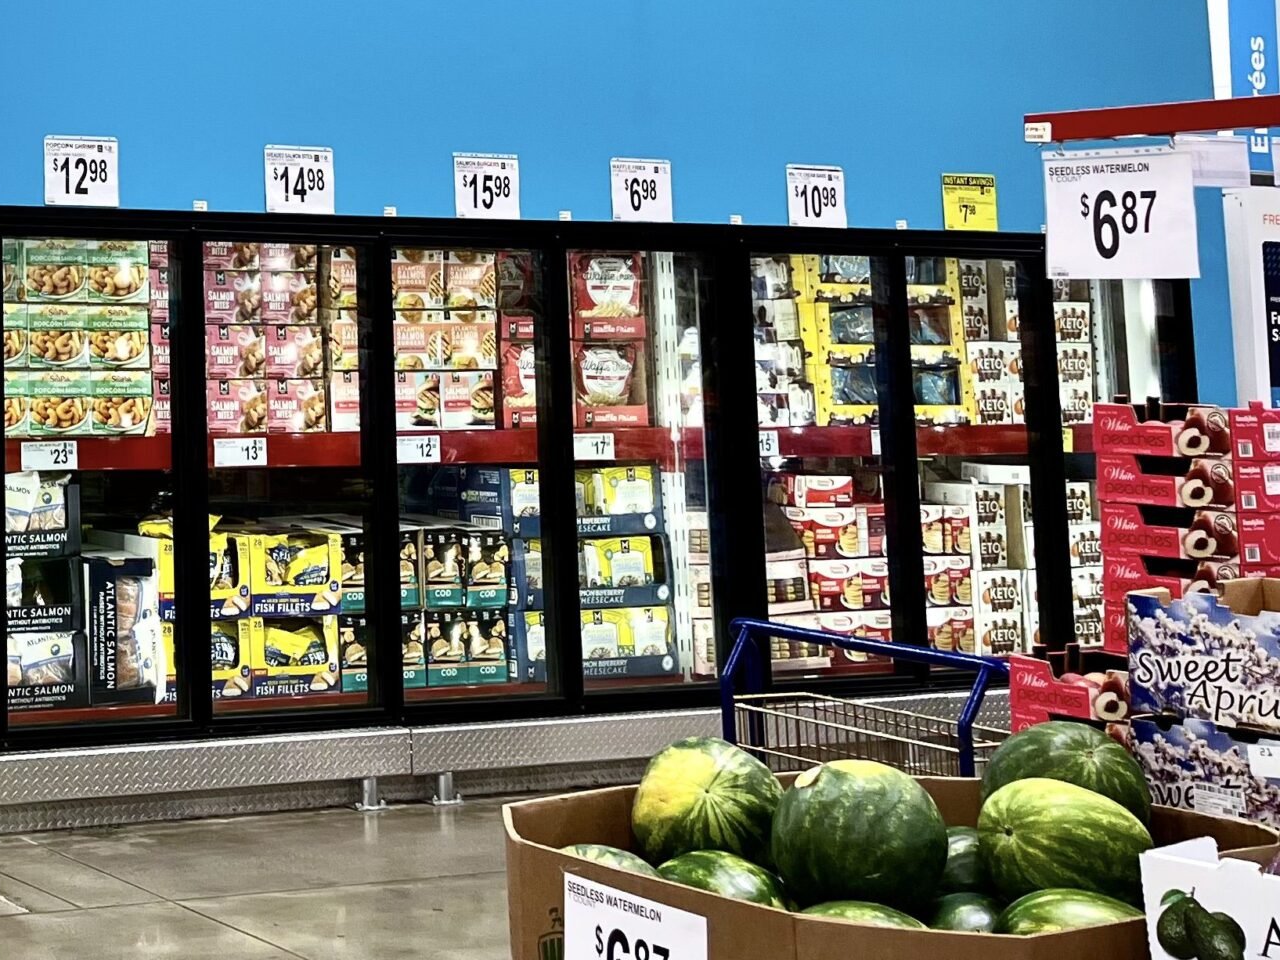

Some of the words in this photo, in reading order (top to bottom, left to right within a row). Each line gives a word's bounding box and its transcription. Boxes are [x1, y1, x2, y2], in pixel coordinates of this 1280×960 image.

[1048, 166, 1091, 176] SEEDLESS
[1092, 163, 1149, 174] WATERMELON
[943, 176, 967, 185] INSTANT
[969, 177, 994, 187] SAVINGS
[1056, 175, 1082, 183] COUNT
[962, 275, 981, 287] ETO
[208, 292, 234, 301] SALMON
[263, 292, 290, 301] SALMON
[965, 316, 982, 327] ETO
[1059, 317, 1084, 329] KETO
[211, 346, 239, 355] SALMON
[977, 358, 1003, 370] KETO
[1060, 359, 1086, 370] KETO
[211, 400, 239, 410] SALMON
[270, 400, 297, 410] SALMON
[979, 400, 1005, 411] KETO
[1101, 416, 1132, 431] White
[1101, 432, 1166, 448] peaches
[1104, 465, 1135, 480] White
[1104, 481, 1169, 498] peaches
[1067, 499, 1084, 510] ETO
[1107, 514, 1139, 530] White
[578, 524, 612, 532] ESECAKE
[5, 535, 27, 544] NTIC
[29, 533, 68, 543] SALMON
[1108, 531, 1172, 548] peaches
[982, 542, 1001, 554] ETO
[1109, 563, 1141, 579] White
[347, 592, 364, 601] COD
[479, 590, 496, 598] COD
[990, 588, 1015, 599] KETO
[580, 596, 624, 604] HEESECAKE
[6, 609, 27, 618] NTIC
[30, 607, 71, 617] SALMON
[105, 581, 115, 637] ATLANTIC
[255, 603, 275, 613] FISH
[277, 602, 311, 613] FILLETS
[162, 626, 172, 634] 28
[990, 629, 1016, 641] KETO
[106, 640, 115, 689] SALMON
[480, 666, 496, 674] COD
[1136, 652, 1243, 684] Sweet
[404, 671, 415, 679] OD
[441, 668, 457, 676] COD
[583, 667, 627, 675] HEESECAKE
[355, 673, 367, 681] CO
[1016, 671, 1049, 688] White
[8, 688, 31, 697] NTIC
[34, 684, 75, 695] SALMON
[256, 685, 275, 696] FISH
[277, 684, 310, 695] FILLETS
[1017, 688, 1082, 708] peaches
[567, 881, 604, 904] SEEDLESS
[606, 894, 662, 923] WATERMELON
[573, 896, 596, 909] COUNT
